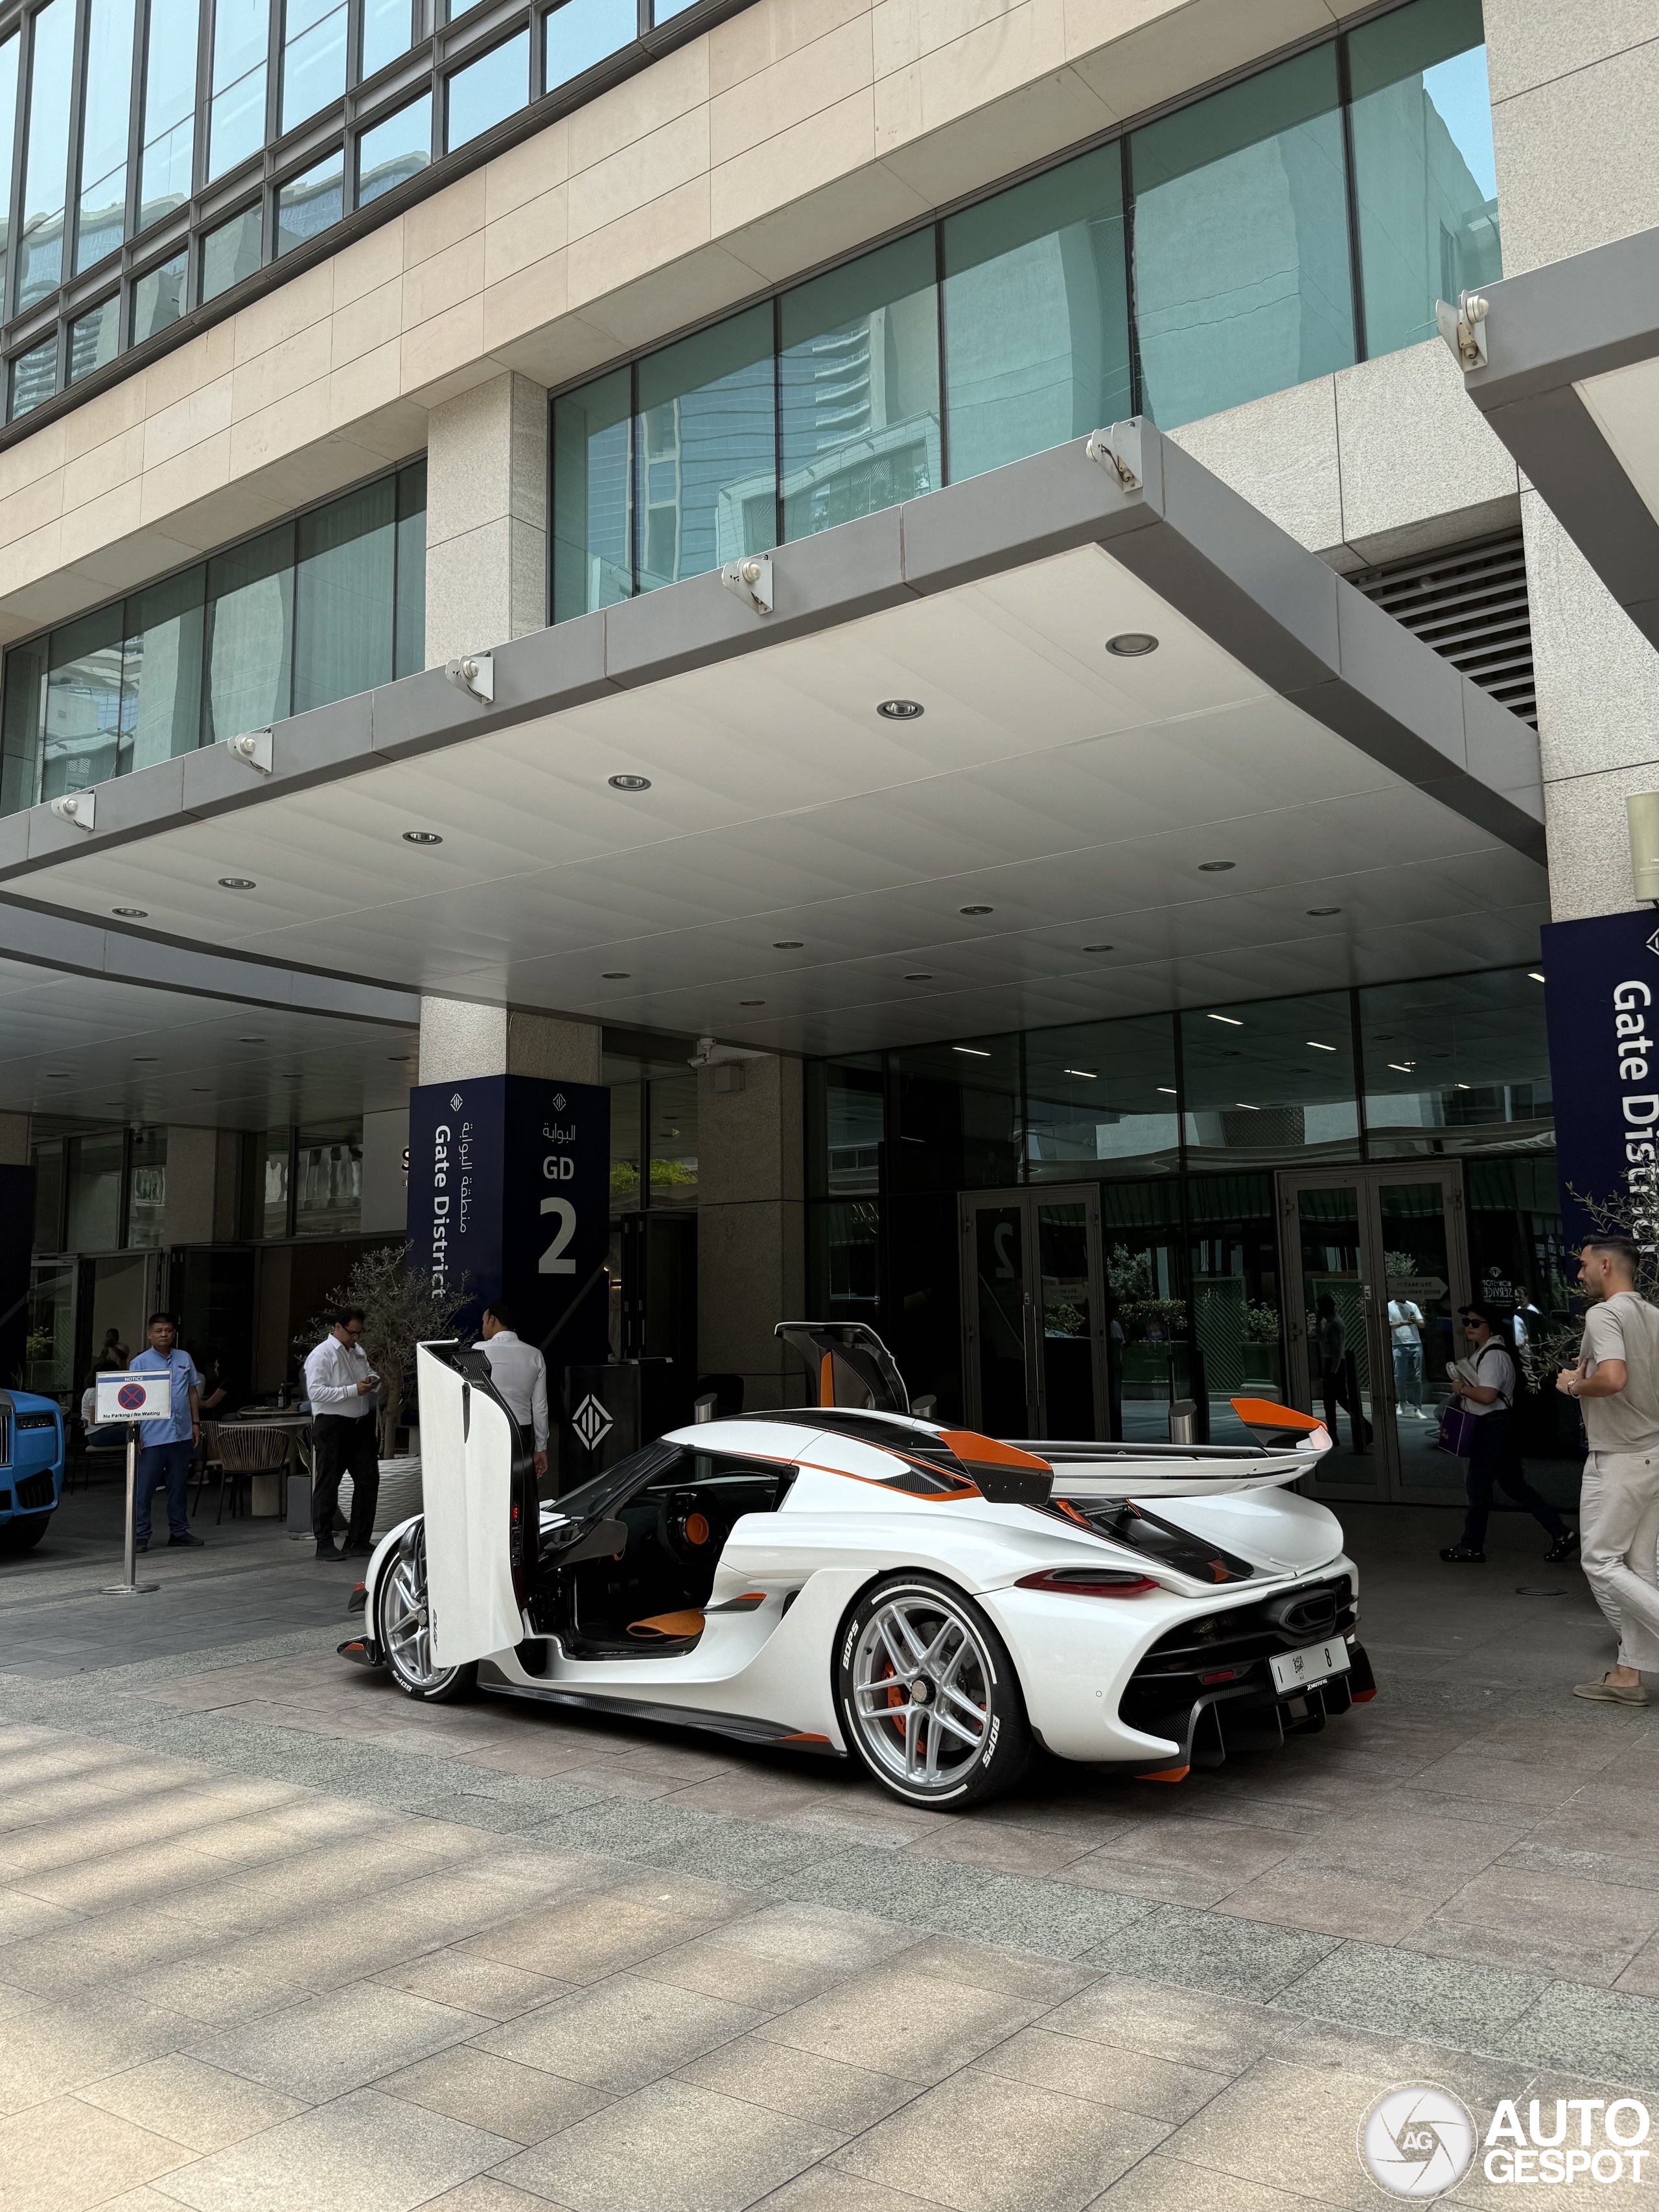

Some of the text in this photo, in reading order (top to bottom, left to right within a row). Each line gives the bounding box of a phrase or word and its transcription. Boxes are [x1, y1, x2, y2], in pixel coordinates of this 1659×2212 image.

[1613, 980, 1654, 1080] Gate
[434, 1125, 450, 1187] Gate
[542, 1123, 576, 1144] البوابة
[459, 1122, 473, 1233] منطقة البوابة
[543, 1156, 574, 1180] GD
[539, 1197, 577, 1274] 2
[842, 1619, 859, 1670] BOPS
[1325, 1648, 1332, 1668] 8
[392, 1670, 413, 1693] BOPS
[982, 1714, 1000, 1768] BOPS
